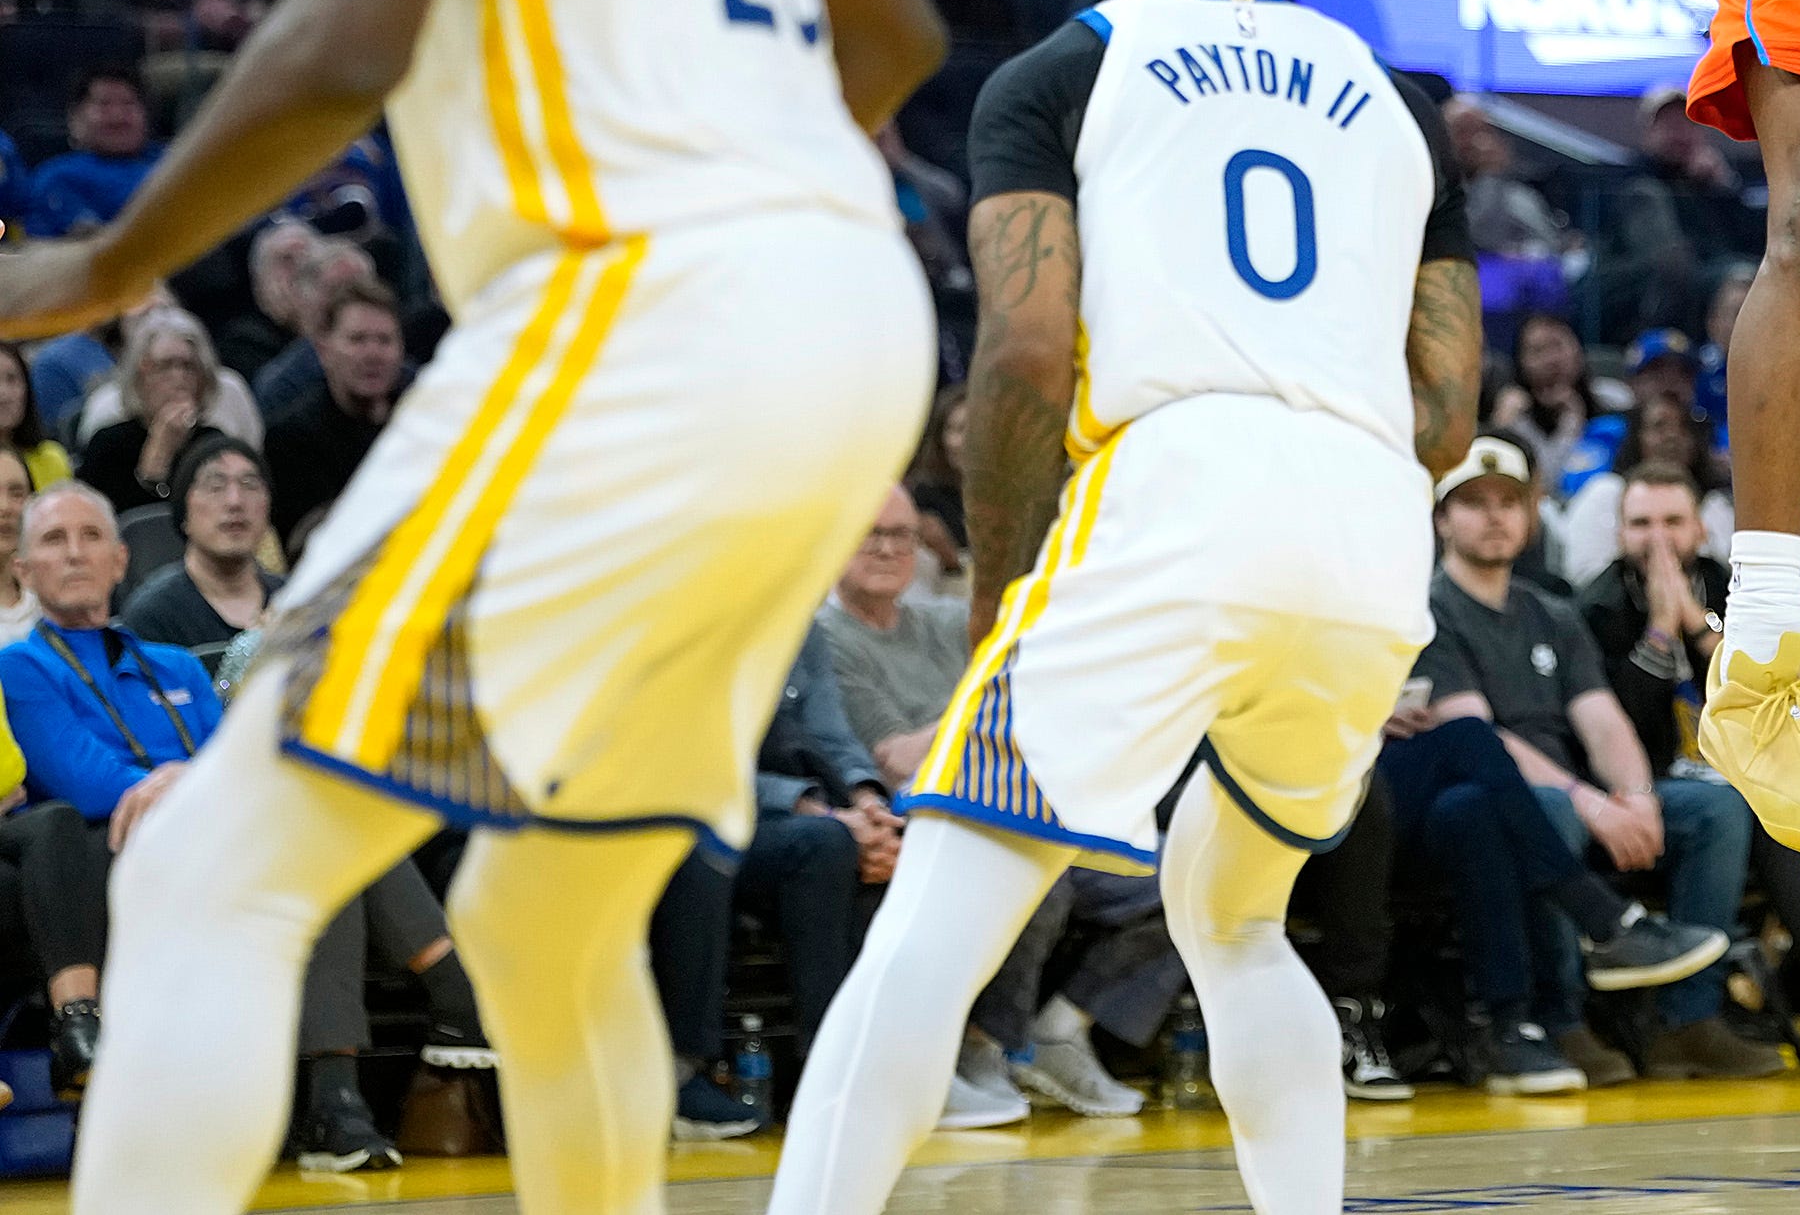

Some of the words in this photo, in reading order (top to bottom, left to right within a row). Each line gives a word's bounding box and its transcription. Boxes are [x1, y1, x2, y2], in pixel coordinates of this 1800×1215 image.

[1145, 44, 1314, 106] PAYTON
[1327, 79, 1372, 130] II
[1223, 148, 1317, 301] 0
